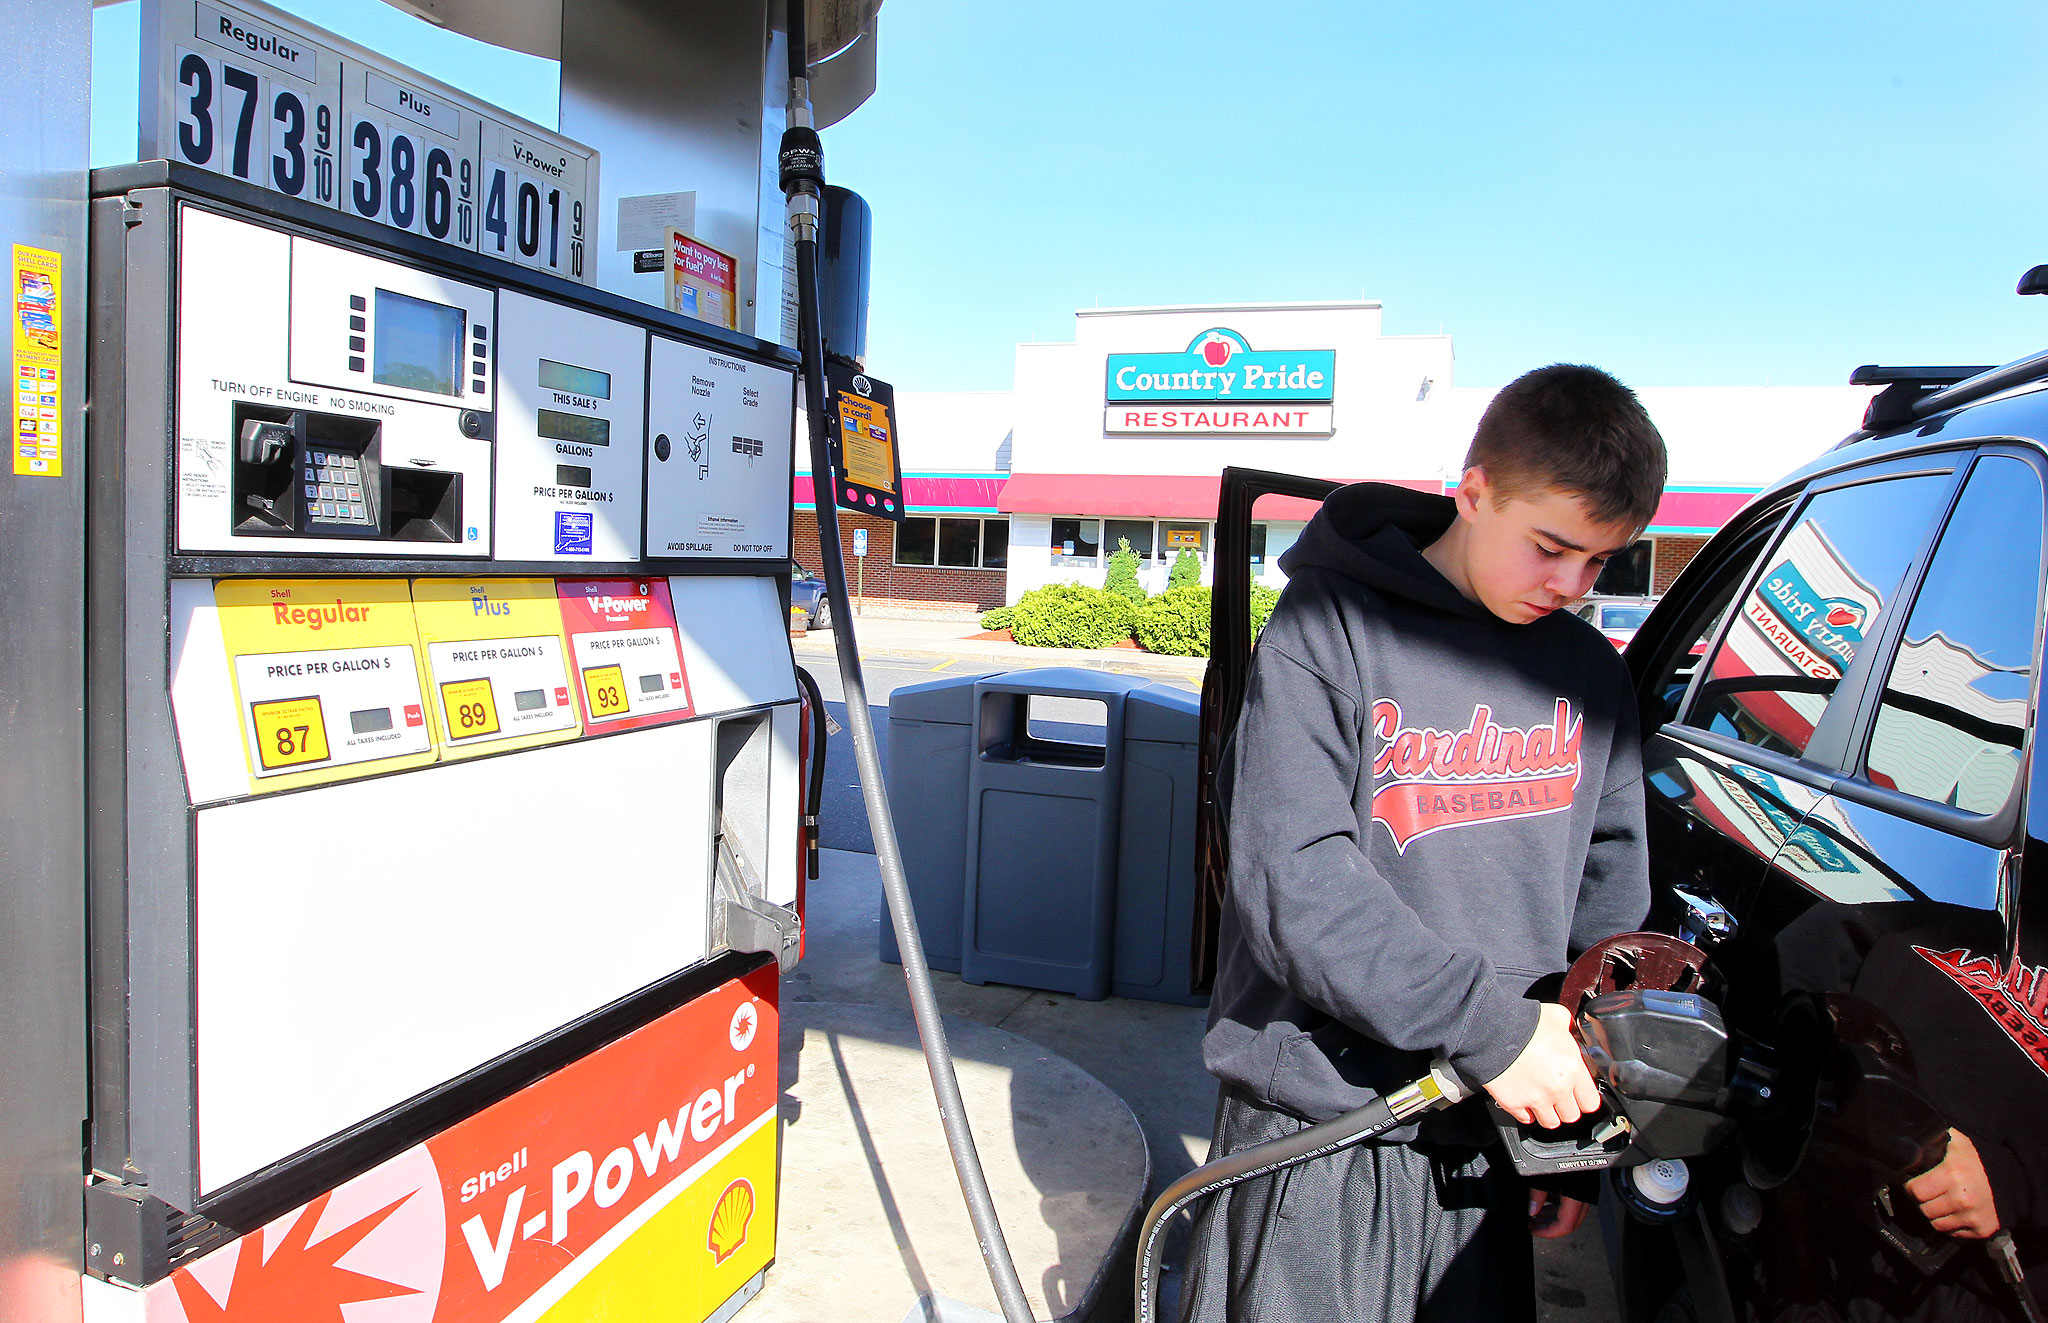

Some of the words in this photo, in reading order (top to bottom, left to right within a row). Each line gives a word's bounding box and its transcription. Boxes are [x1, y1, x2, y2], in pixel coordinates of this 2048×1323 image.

[219, 16, 300, 63] Regular
[399, 90, 432, 117] Plus
[179, 54, 305, 196] 373
[513, 144, 563, 177] V-Power
[782, 148, 810, 158] OPW
[352, 120, 452, 239] 386
[485, 168, 560, 268] 401
[18, 256, 36, 264] SHELL
[37, 260, 58, 268] CARDS
[674, 239, 693, 257] Want
[694, 248, 702, 260] to
[704, 254, 717, 270] pay
[718, 256, 729, 272] less
[674, 252, 685, 266] for
[686, 256, 704, 274] fuel?
[708, 356, 746, 373] INSTRUCTIONS
[691, 375, 715, 388] Remove
[1115, 365, 1238, 395] Country
[1242, 364, 1325, 391] Pride
[211, 379, 246, 394] TURN
[250, 385, 273, 398] OFF
[277, 389, 319, 405] ENGINE
[330, 397, 345, 409] NO
[348, 400, 395, 415] SMOKING
[553, 392, 570, 405] THIS
[572, 396, 590, 409] SALE
[592, 400, 597, 410] $
[691, 386, 711, 398] Nozzle
[742, 387, 759, 398] Select
[742, 397, 759, 408] Grade
[842, 395, 873, 411] Choose
[851, 410, 872, 421] card!
[1124, 411, 1310, 428] RESTAURANT
[556, 443, 593, 458] GALLONS
[533, 486, 556, 498] PRICE
[559, 488, 573, 499] PER
[575, 490, 606, 502] GALLON
[608, 492, 613, 503] $
[667, 542, 685, 551] AVOID
[686, 543, 713, 551] SPILLAGE
[733, 544, 741, 552] DO
[742, 544, 752, 552] NOT
[270, 589, 291, 599] Shell
[470, 586, 485, 594] Shell
[585, 585, 598, 593] Shell
[472, 595, 511, 617] Plus
[587, 595, 647, 614] V-Power
[273, 599, 370, 631] Regular
[590, 640, 611, 650] PRICE
[611, 639, 625, 649] PER
[626, 637, 654, 648] GALLON
[655, 637, 660, 645] $
[453, 650, 479, 662] PRICE
[481, 649, 499, 661] PER
[500, 647, 535, 660] GALLON
[538, 646, 543, 656] $
[267, 663, 303, 678] PRICE
[306, 661, 330, 675] PER
[332, 658, 380, 673] GALLON
[384, 657, 391, 669] $
[556, 692, 568, 700] Push
[598, 686, 619, 708] 93
[407, 711, 421, 720] Push
[459, 702, 486, 728] 89
[276, 725, 309, 756] 87
[375, 733, 402, 742] INCLUDED
[1416, 785, 1558, 815] BASEBALL
[1558, 1161, 1580, 1170] REMOVE
[460, 1146, 528, 1204] Shell
[460, 1068, 746, 1293] V-Power
[1200, 1176, 1243, 1196] FUTURA
[1140, 1279, 1149, 1323] UTURA
